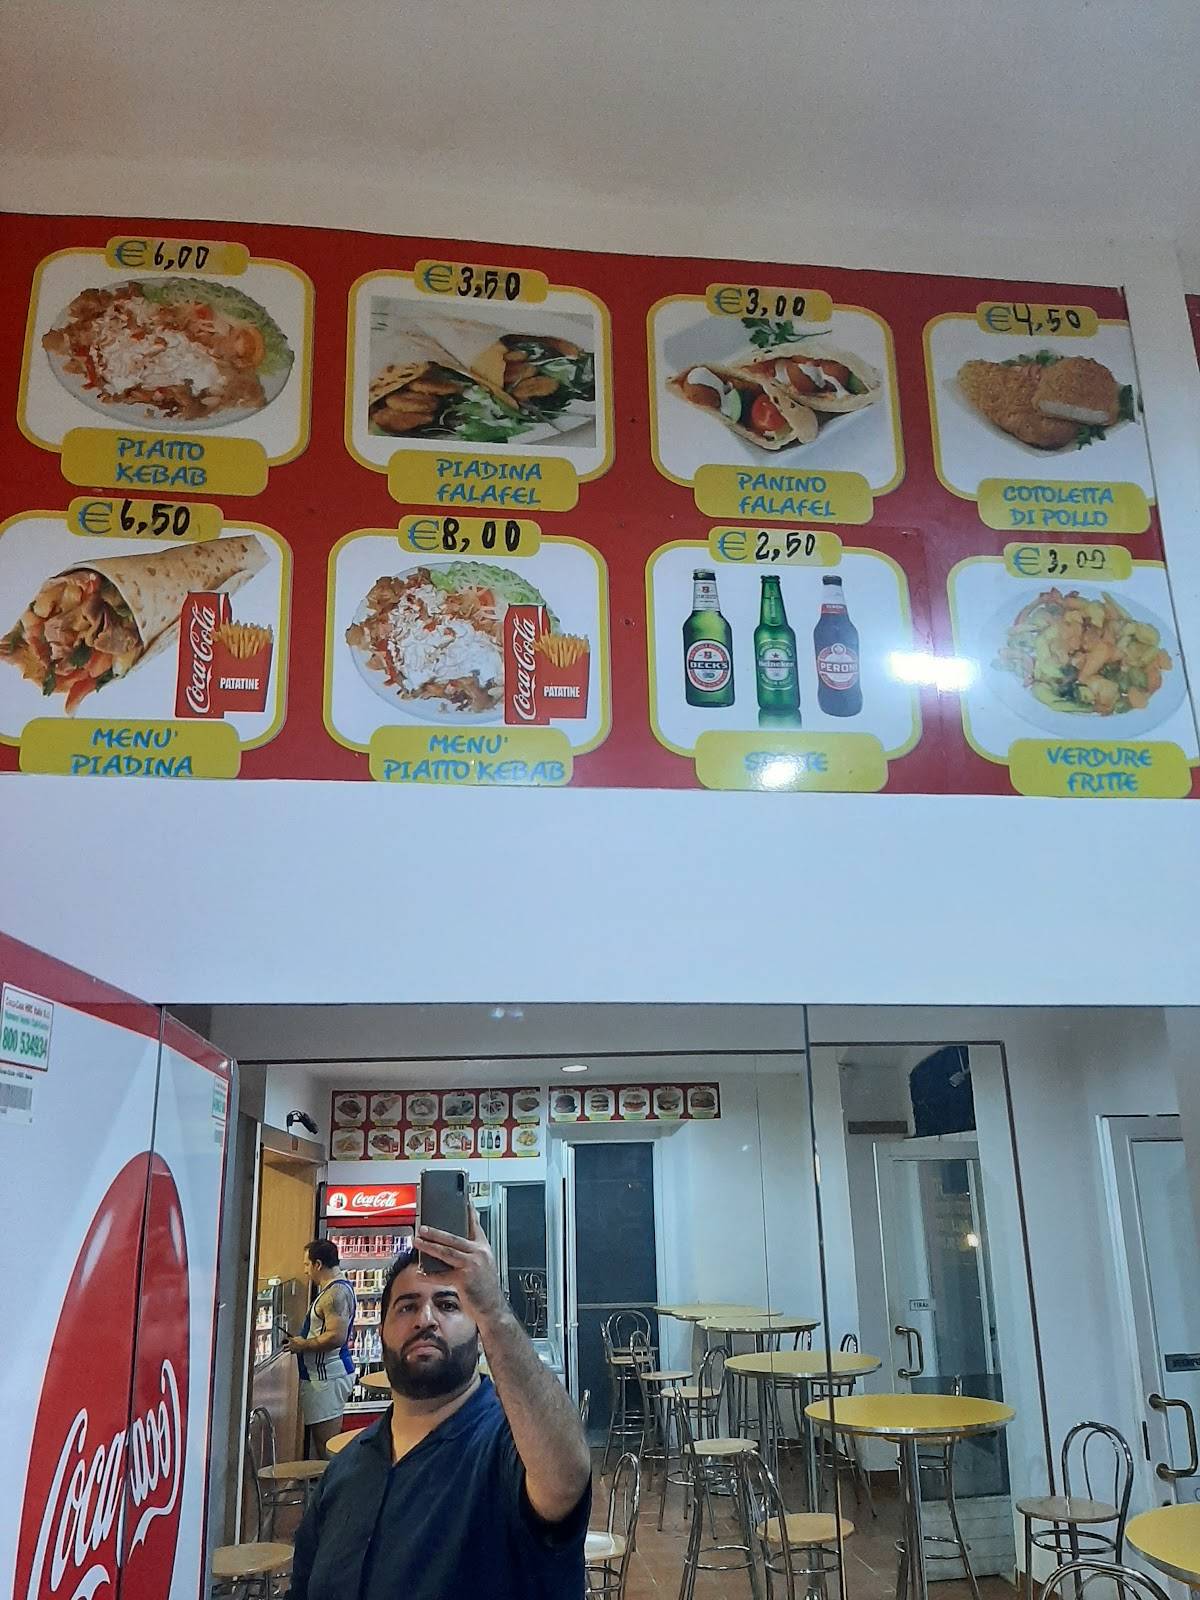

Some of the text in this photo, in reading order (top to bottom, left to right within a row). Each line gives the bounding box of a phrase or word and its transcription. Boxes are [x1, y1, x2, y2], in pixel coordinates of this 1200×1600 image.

[118, 437, 205, 460] PIATTO
[115, 462, 207, 486] KEBAB
[436, 458, 542, 481] PIADINA
[736, 472, 826, 493] PANINO
[436, 483, 541, 505] FALAFEL
[1003, 485, 1114, 504] COTOLETTA
[738, 495, 835, 517] FALAFEL
[1009, 508, 1108, 527] DI POLLO
[220, 677, 260, 690] PATATINE
[543, 685, 580, 698] PATATINE
[92, 727, 178, 748] MENU'
[429, 735, 508, 754] MENU'
[70, 754, 193, 777] PIADINA
[1047, 747, 1152, 767] VERDURE
[384, 759, 565, 781] PIATTO KEBAB
[1068, 772, 1138, 793] FRITTE
[2, 1026, 18, 1052] 800
